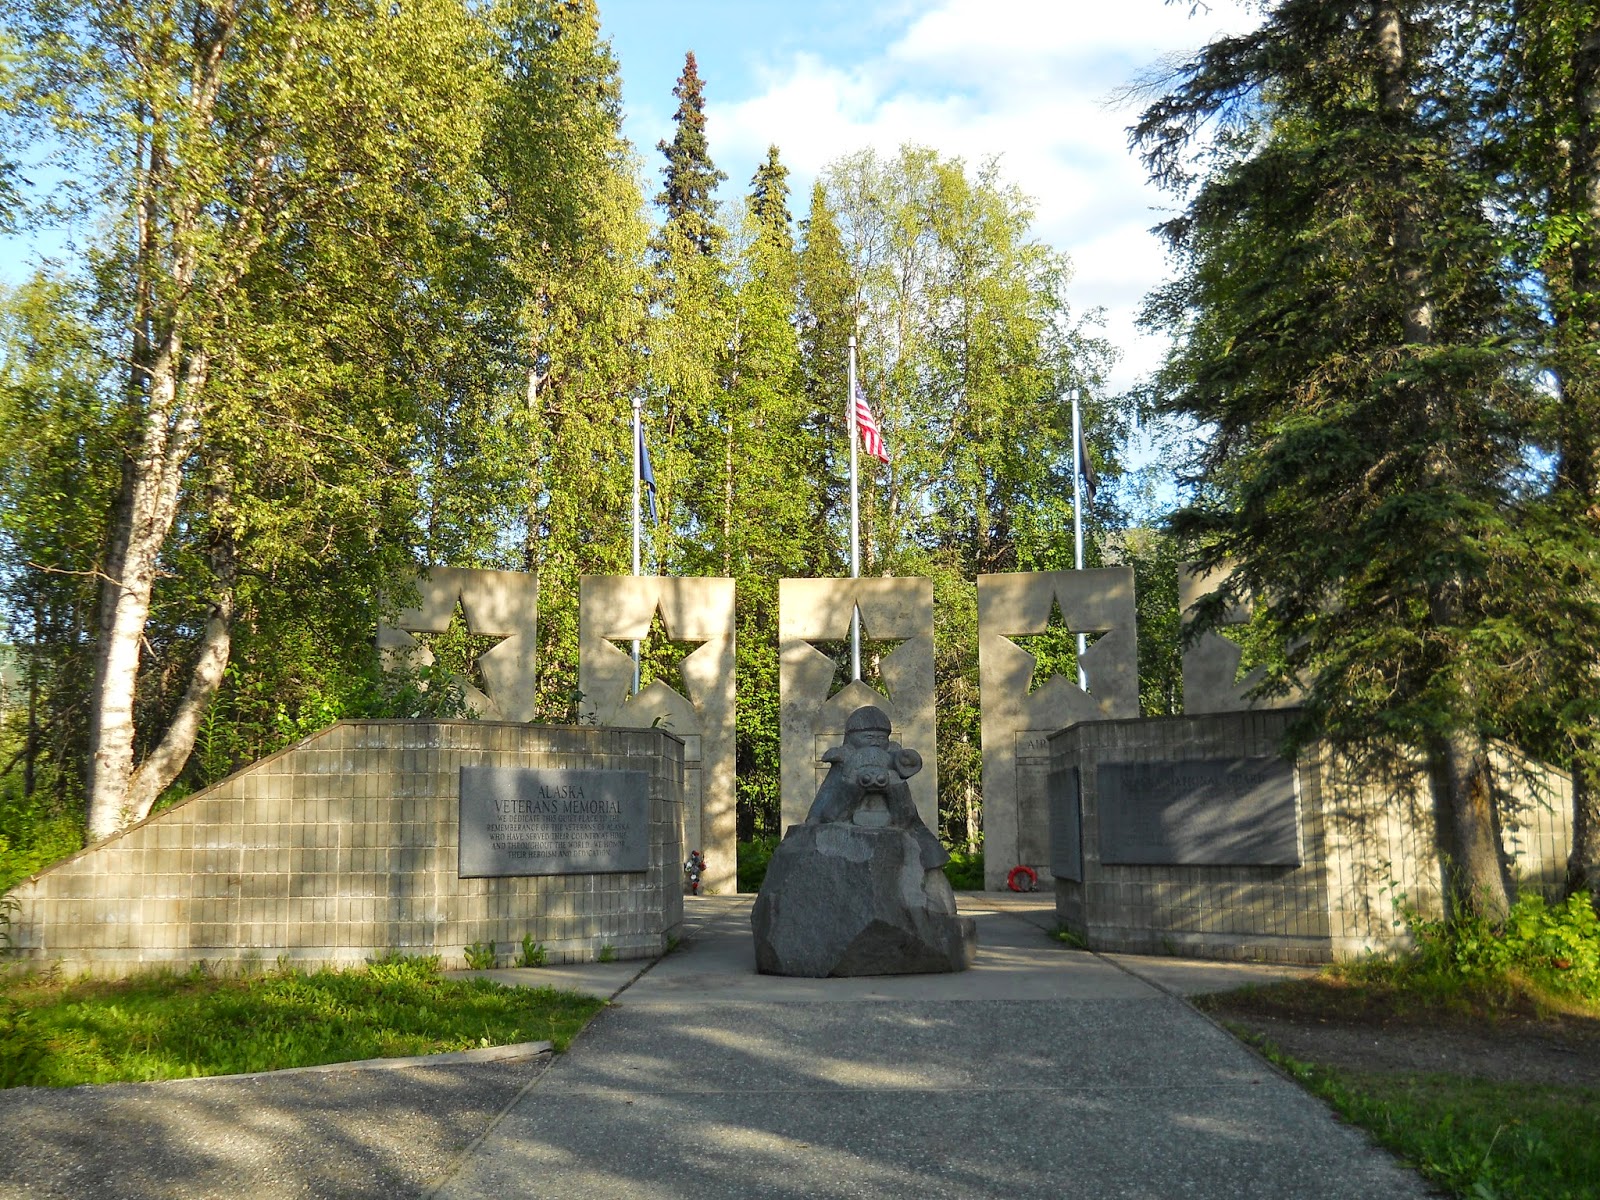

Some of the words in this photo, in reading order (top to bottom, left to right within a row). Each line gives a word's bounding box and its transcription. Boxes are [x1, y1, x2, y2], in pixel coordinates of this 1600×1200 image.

[538, 785, 584, 799] ALASKA
[494, 799, 558, 813] VETERANS
[563, 800, 622, 814] MEMORIAL
[509, 814, 540, 822] DEDICATE
[579, 814, 598, 822] PLACE
[551, 824, 563, 832] THE
[607, 823, 630, 831] ALASKA
[490, 833, 505, 841] WHO
[552, 832, 570, 840] THEIR
[571, 832, 600, 840] COUNTRY
[493, 842, 506, 850] AND
[508, 841, 553, 850] THROUGHOUT
[555, 841, 566, 849] THE
[508, 851, 527, 859] THEIR
[528, 850, 557, 858] HEROISM
